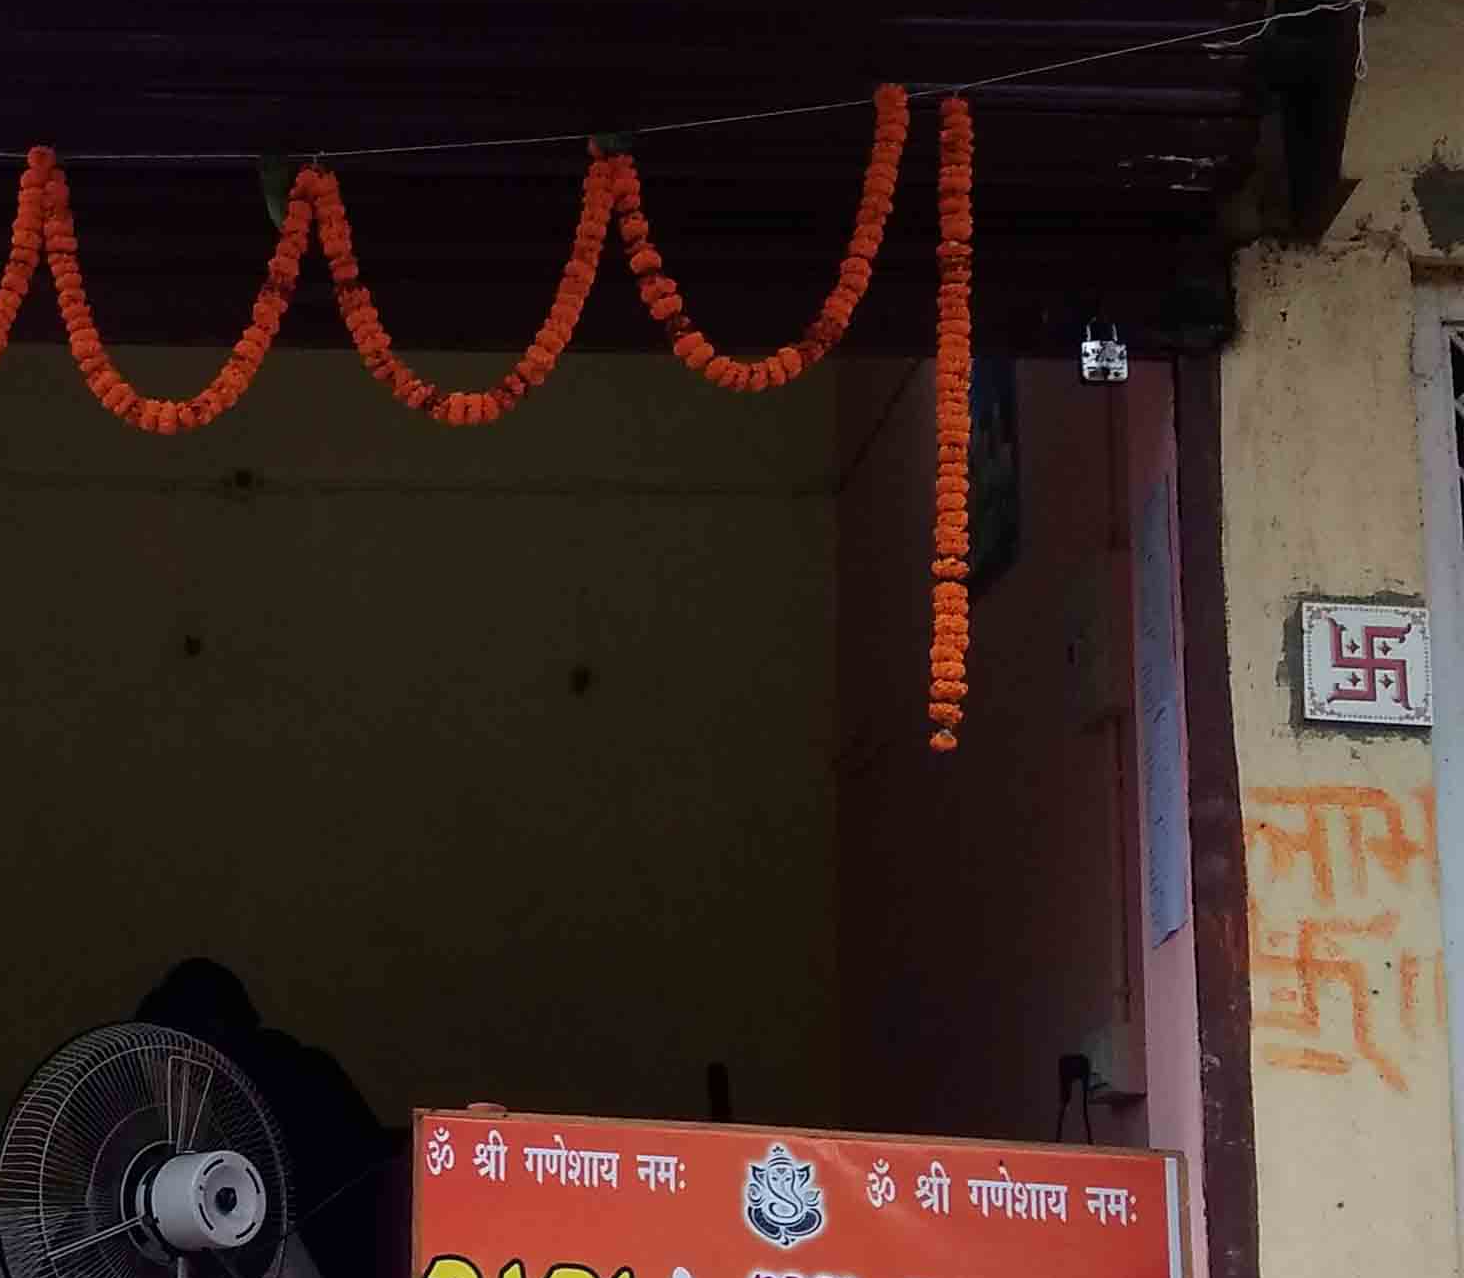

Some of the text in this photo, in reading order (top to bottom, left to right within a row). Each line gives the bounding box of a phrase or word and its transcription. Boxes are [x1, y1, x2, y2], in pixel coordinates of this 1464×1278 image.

[472, 1129, 508, 1182] श्री
[523, 1134, 620, 1188] गणेशाय
[636, 1154, 687, 1193] नमः
[915, 1161, 951, 1214] श्री
[967, 1165, 1068, 1224] गणेशाय
[1085, 1186, 1138, 1225] नमः
